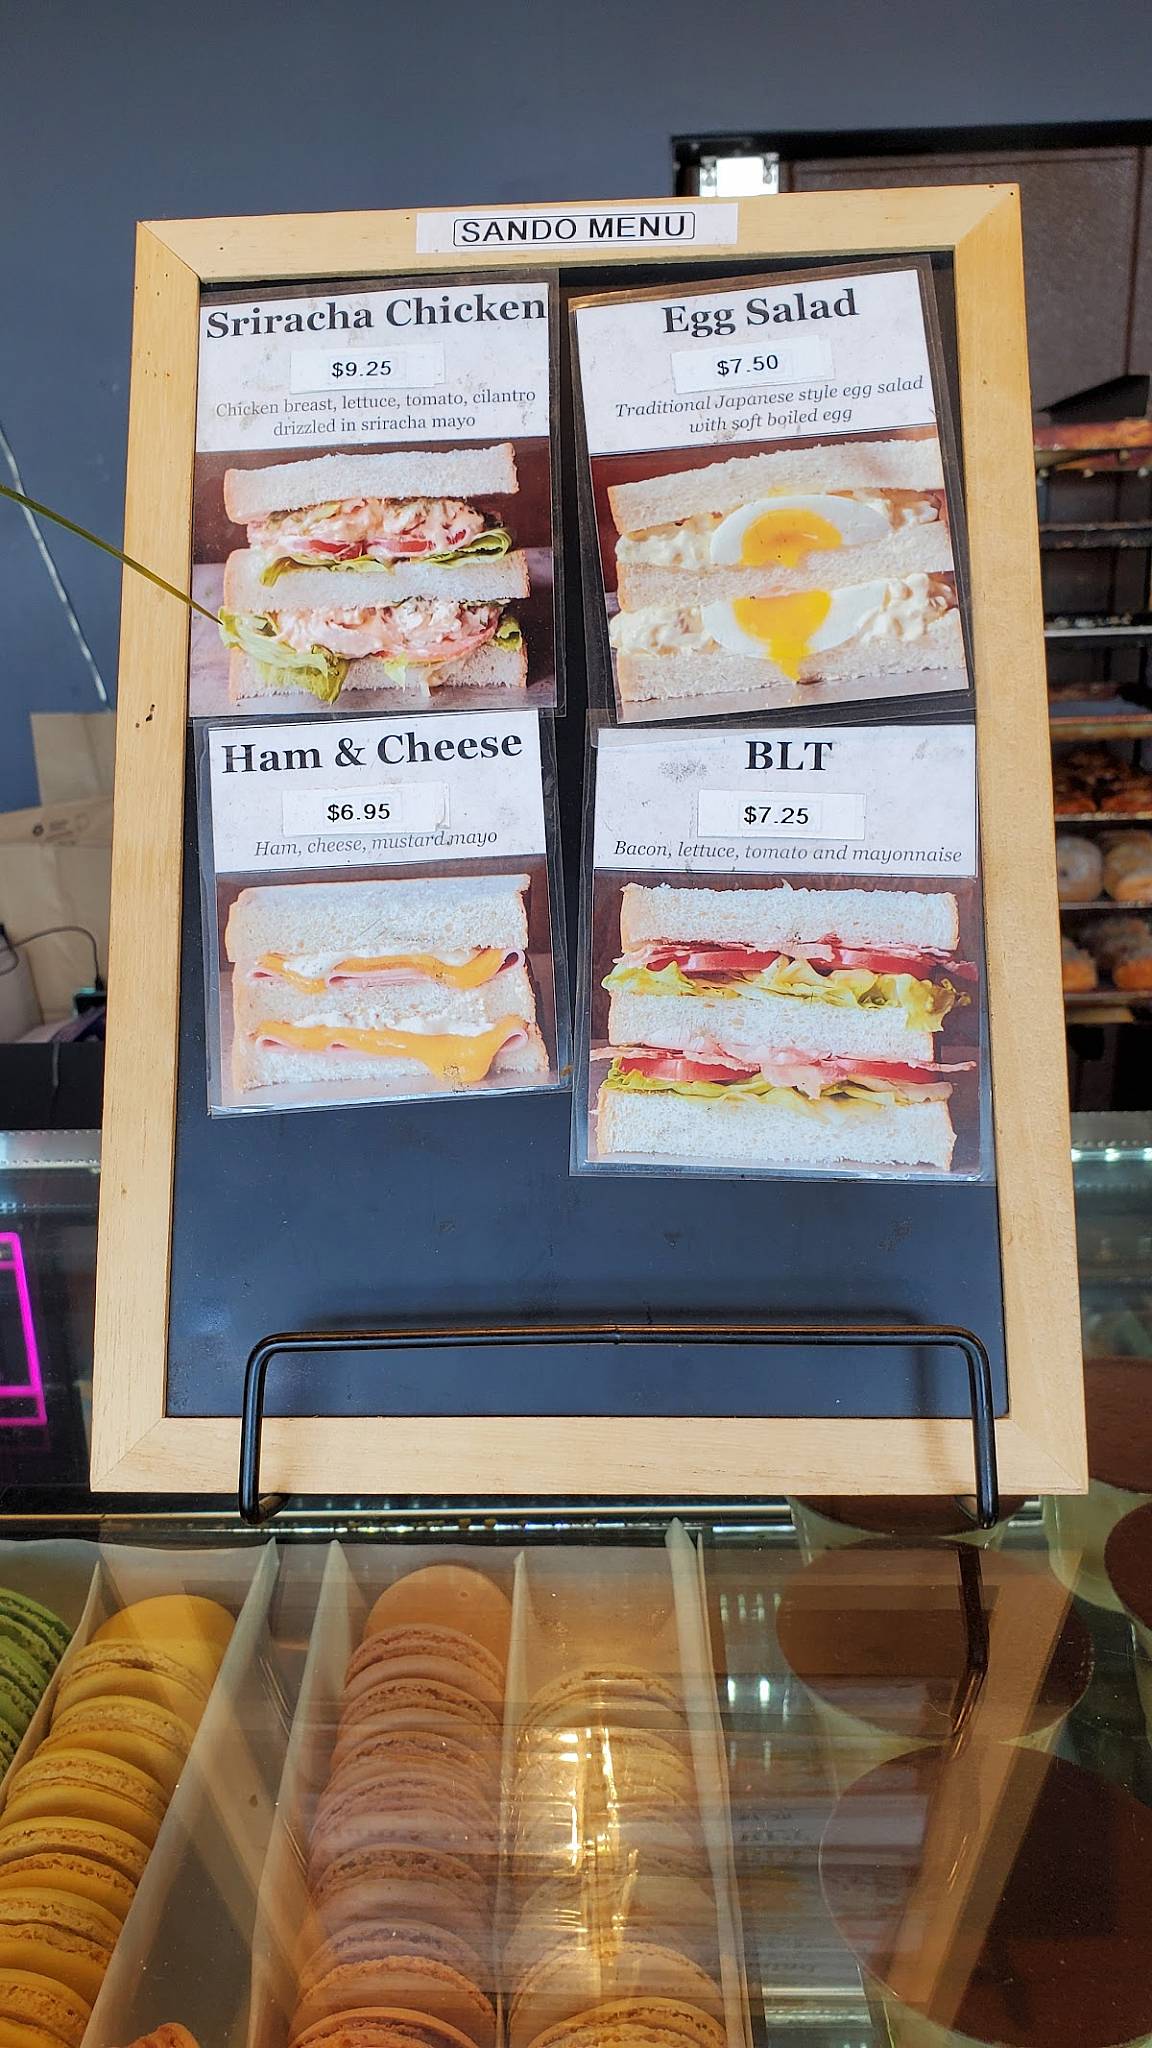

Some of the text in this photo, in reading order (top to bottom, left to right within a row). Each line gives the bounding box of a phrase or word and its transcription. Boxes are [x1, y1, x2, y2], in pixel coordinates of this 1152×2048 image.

[461, 216, 685, 243] SANDO MENU
[206, 294, 547, 339] Sriracha Chicken
[662, 288, 860, 338] Egg Salad
[331, 360, 392, 379] $9.25
[717, 355, 778, 377] $7.50
[216, 389, 536, 418] Chicken breast, lettuce, tomato, cilantro
[615, 376, 924, 418] Traditional Japanese style egg salad
[273, 414, 476, 437] drizzled in sriracha mayo
[689, 407, 853, 434] with soft boiled egg
[222, 732, 522, 774] Ham & Cheese
[745, 741, 832, 771] BLT
[327, 804, 390, 822] $6.95
[744, 806, 809, 825] $7.25
[255, 841, 302, 858] Ham,
[308, 838, 367, 854] cheese,
[614, 841, 962, 864] Bacon, lettuce, tomato and mayonnaise
